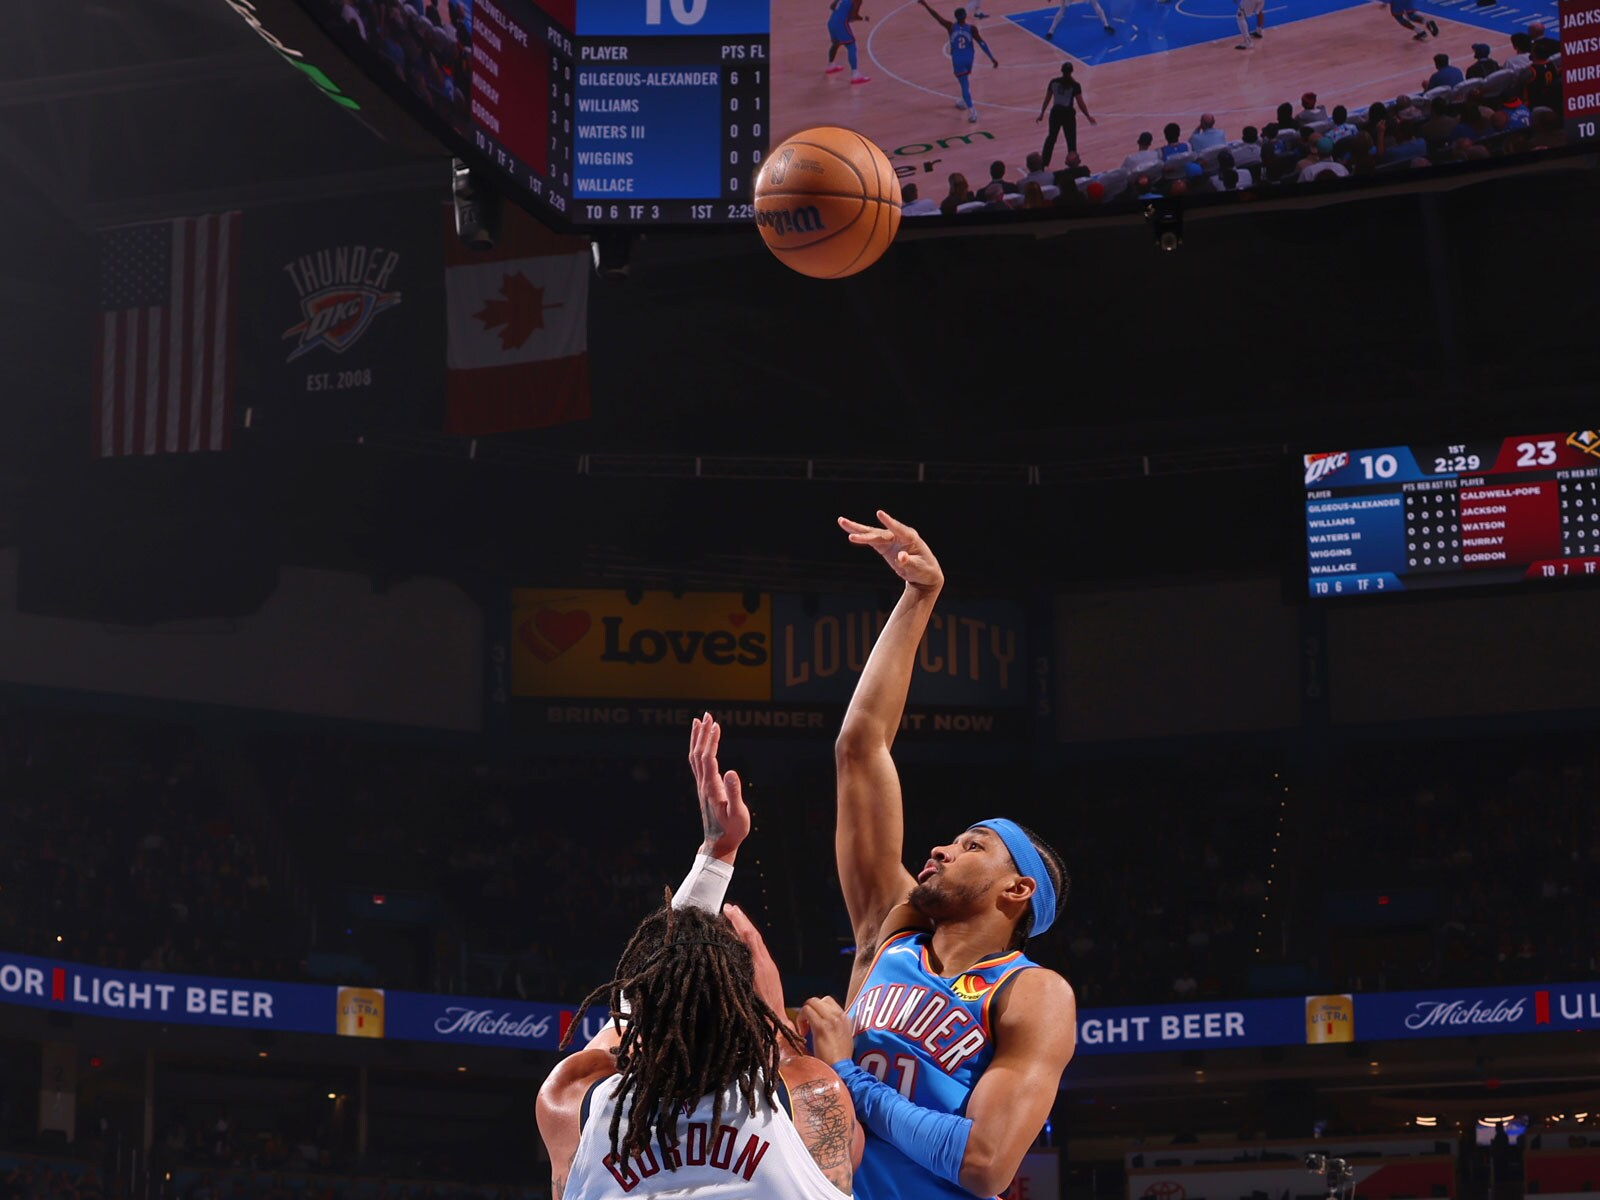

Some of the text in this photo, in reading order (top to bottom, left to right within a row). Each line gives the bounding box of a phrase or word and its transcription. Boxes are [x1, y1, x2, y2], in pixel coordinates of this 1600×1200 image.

[581, 45, 765, 60] PLAYER PTS FL
[1564, 37, 1600, 56] WATS
[579, 71, 761, 86] GILGEOUS-ALEXANDER 6 1
[579, 97, 760, 112] WILLIAMS 0 1
[578, 123, 761, 139] WATERS III 0 0
[1577, 121, 1595, 138] TO
[578, 150, 760, 165] WIGGINS 0 0
[577, 177, 738, 192] WALLACE 0
[586, 205, 602, 219] TO
[610, 205, 618, 219] 6
[629, 205, 644, 219] TF
[651, 204, 659, 218] 3
[691, 204, 712, 218] 1ST
[283, 245, 400, 297] THUNDER
[305, 297, 361, 341] OKC
[306, 368, 372, 391] EST. 2008
[1448, 445, 1466, 454] 1ST
[1516, 441, 1557, 467] 23
[1305, 452, 1347, 484] OKC
[1360, 454, 1398, 479] 10
[1434, 455, 1480, 473] 2:29
[1307, 490, 1331, 499] PLAYER
[1460, 482, 1596, 500] CALDWELL-POPE 5 1
[1308, 498, 1400, 513] GILGEOUS-ALEXANDER
[1461, 498, 1597, 516] JACKSON 0 1
[1309, 517, 1355, 528] WILLIAMS
[1422, 511, 1429, 519] 0
[1436, 510, 1443, 518] 0
[1451, 509, 1456, 517] 1
[1462, 521, 1505, 531] WATSON
[1591, 513, 1599, 522] 0
[1310, 533, 1349, 543] WATERS
[1463, 529, 1599, 547] MURRAY 7 0 0
[1311, 548, 1352, 558] WIGGINS
[1409, 543, 1416, 551] 0
[1423, 542, 1430, 550] 0
[1452, 540, 1458, 548] 0
[1464, 552, 1506, 562] GORDON
[1311, 555, 1459, 574] WALLACE 0 0 0 0
[1542, 562, 1597, 577] TO 7 TF
[1316, 578, 1384, 594] TO 6 TF 3
[601, 616, 767, 666] Loves
[785, 610, 1016, 690] LOU CITY
[547, 706, 824, 728] BRING THE HUNDER
[934, 714, 993, 732] NOW
[73, 975, 175, 1011] LIGHT
[186, 985, 274, 1018] BEER
[434, 1005, 552, 1039] Michelob
[1404, 996, 1527, 1030] Michelob
[852, 983, 987, 1075] THUNDER
[1075, 1011, 1245, 1044] GHT BEER
[601, 1121, 771, 1193] GORDON
